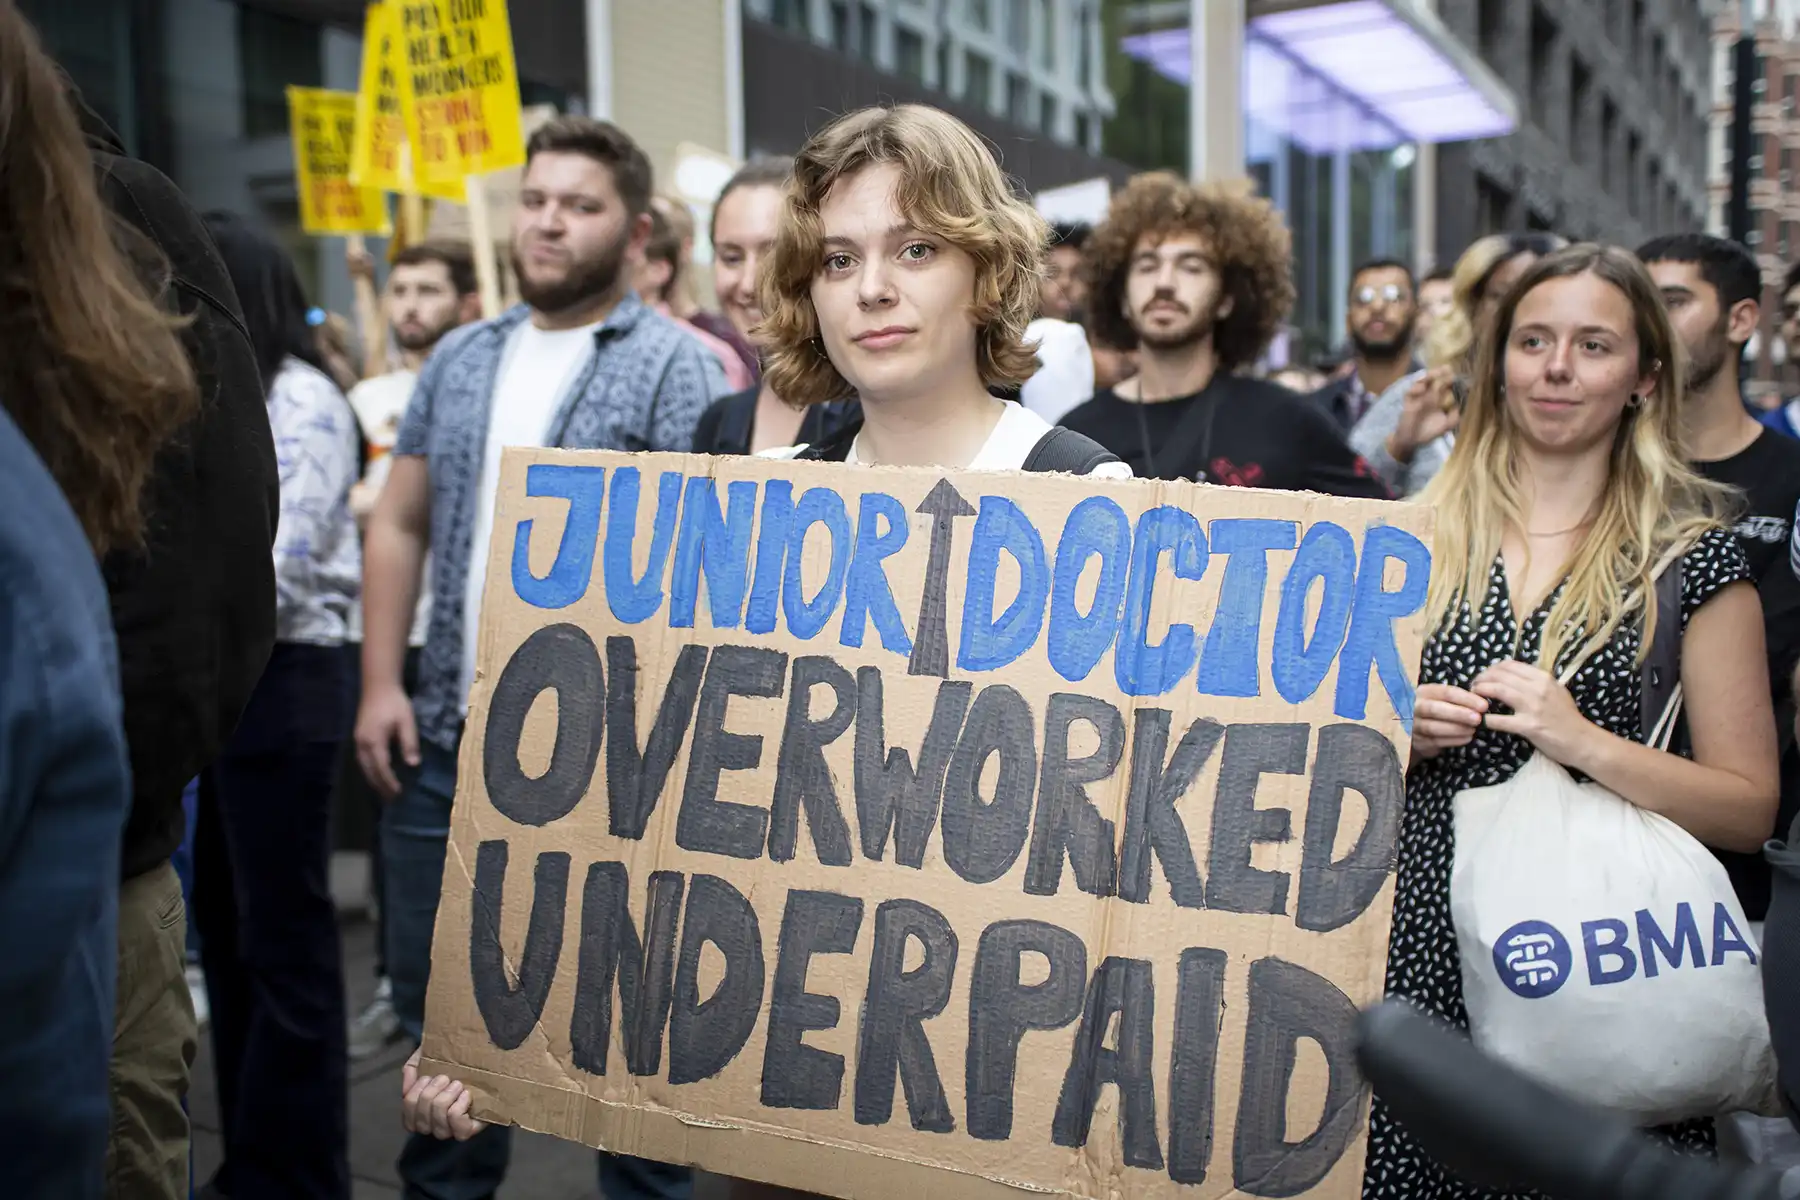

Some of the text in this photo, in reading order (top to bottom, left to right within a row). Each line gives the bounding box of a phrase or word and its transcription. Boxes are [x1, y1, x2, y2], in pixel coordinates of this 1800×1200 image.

[511, 464, 1432, 737] JUNIOR DOCTOR
[483, 622, 1405, 932] OVERWORKED
[470, 838, 1373, 1198] UNDERPAID
[1580, 901, 1758, 986] BMA
